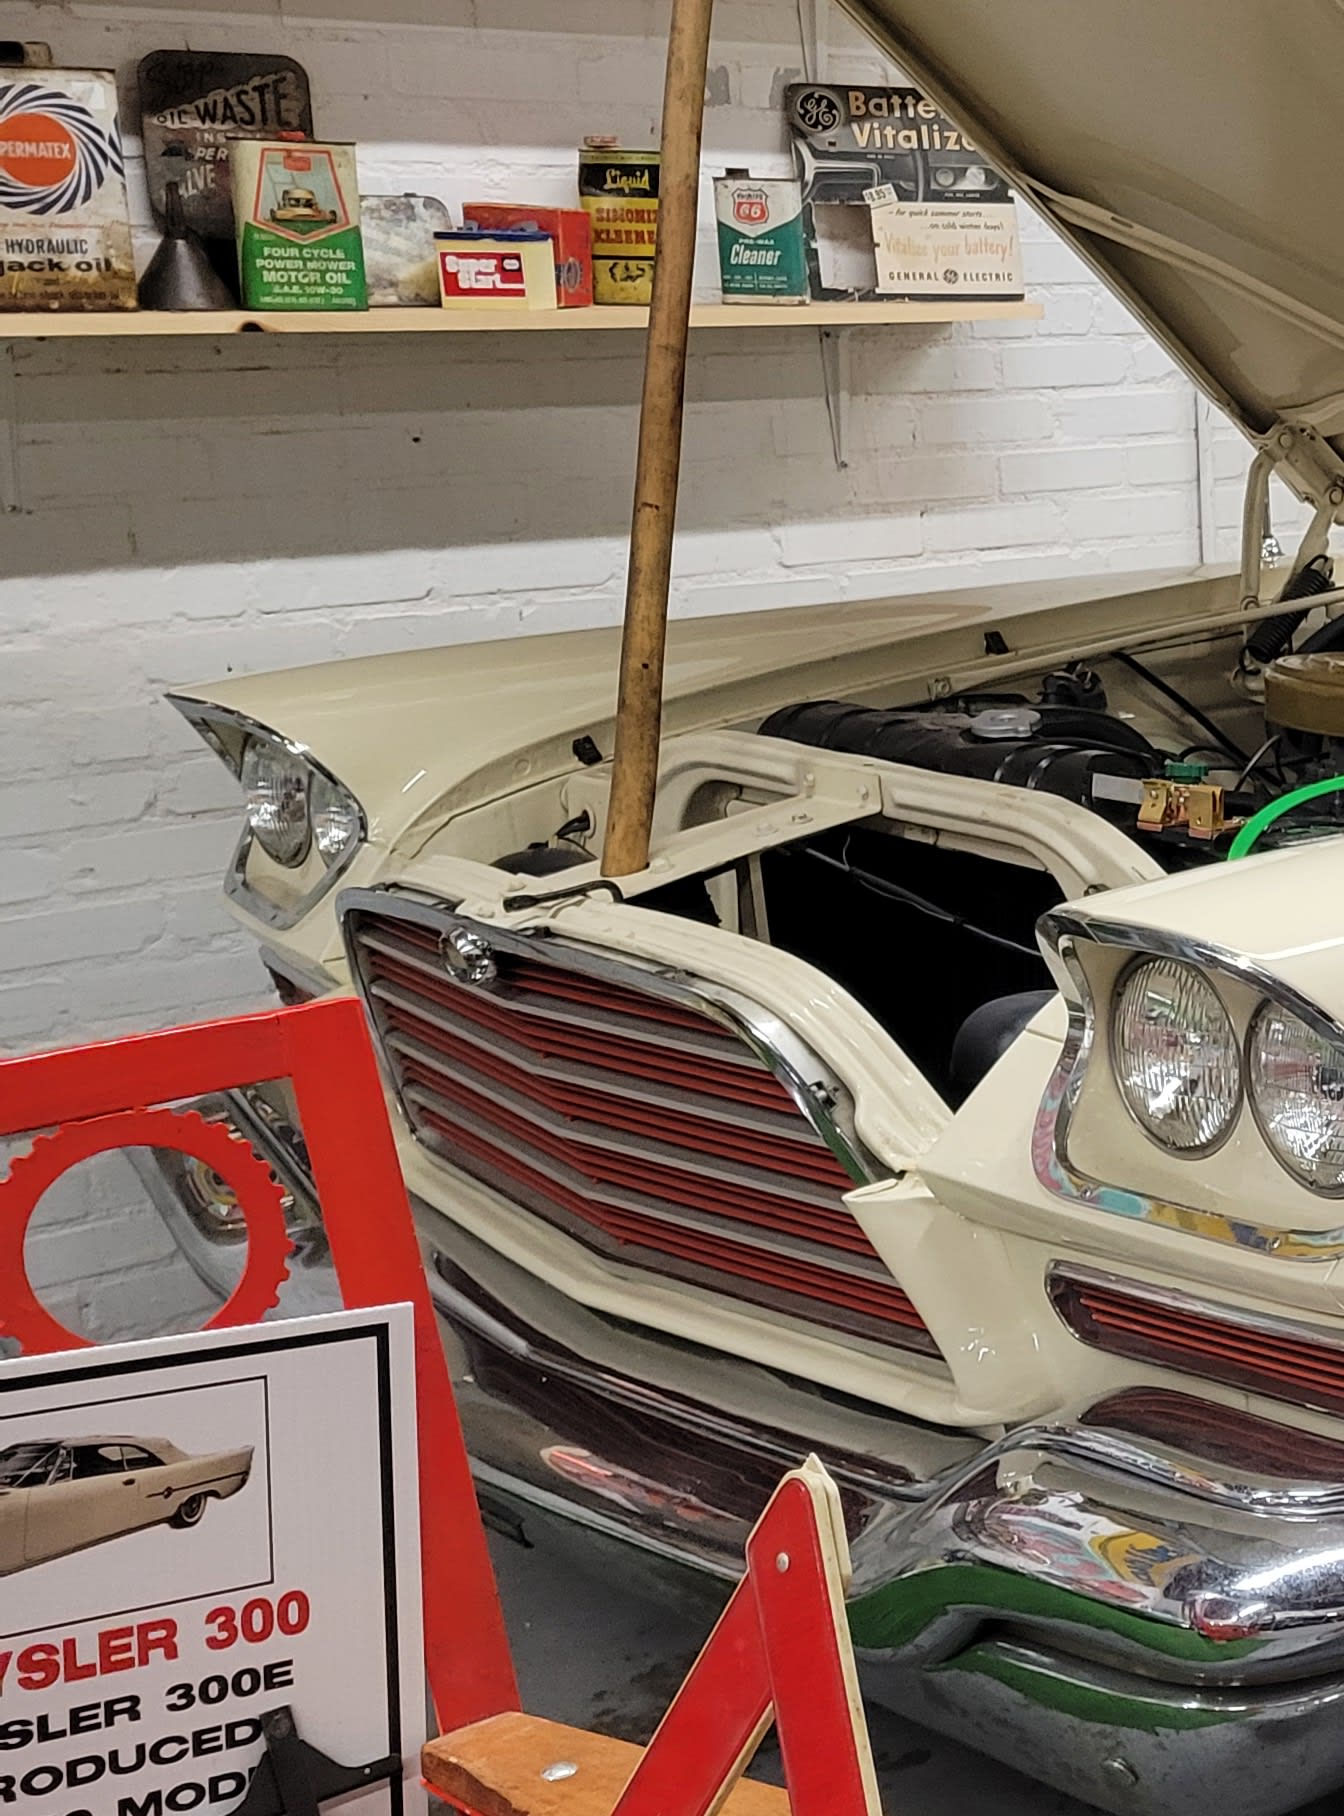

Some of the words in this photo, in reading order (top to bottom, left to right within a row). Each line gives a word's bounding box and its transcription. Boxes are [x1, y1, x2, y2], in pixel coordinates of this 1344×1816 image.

[157, 111, 187, 125] OIL
[195, 76, 291, 127] WASTE
[848, 91, 945, 119] Batte
[0, 140, 71, 159] PERMATEX
[603, 168, 650, 193] Liquid
[740, 203, 761, 218] 66
[594, 228, 656, 244] KLEENE
[5, 238, 88, 255] HYDRAULIC
[263, 246, 299, 258] FOUR
[302, 248, 345, 259] CYCLE
[730, 244, 782, 266] Cleaner
[931, 243, 960, 263] your
[964, 233, 1014, 262] battery!
[74, 256, 112, 272] oil
[256, 259, 304, 269] POWER
[306, 260, 356, 271] MOWER
[262, 270, 321, 283] MOTOR
[325, 271, 352, 284] OIL
[889, 271, 939, 281] GENERAL
[963, 272, 1013, 282] ELECTRIC
[205, 1590, 310, 1650] 300
[165, 1659, 294, 1711] 300E
[117, 1766, 256, 1816] MOD
